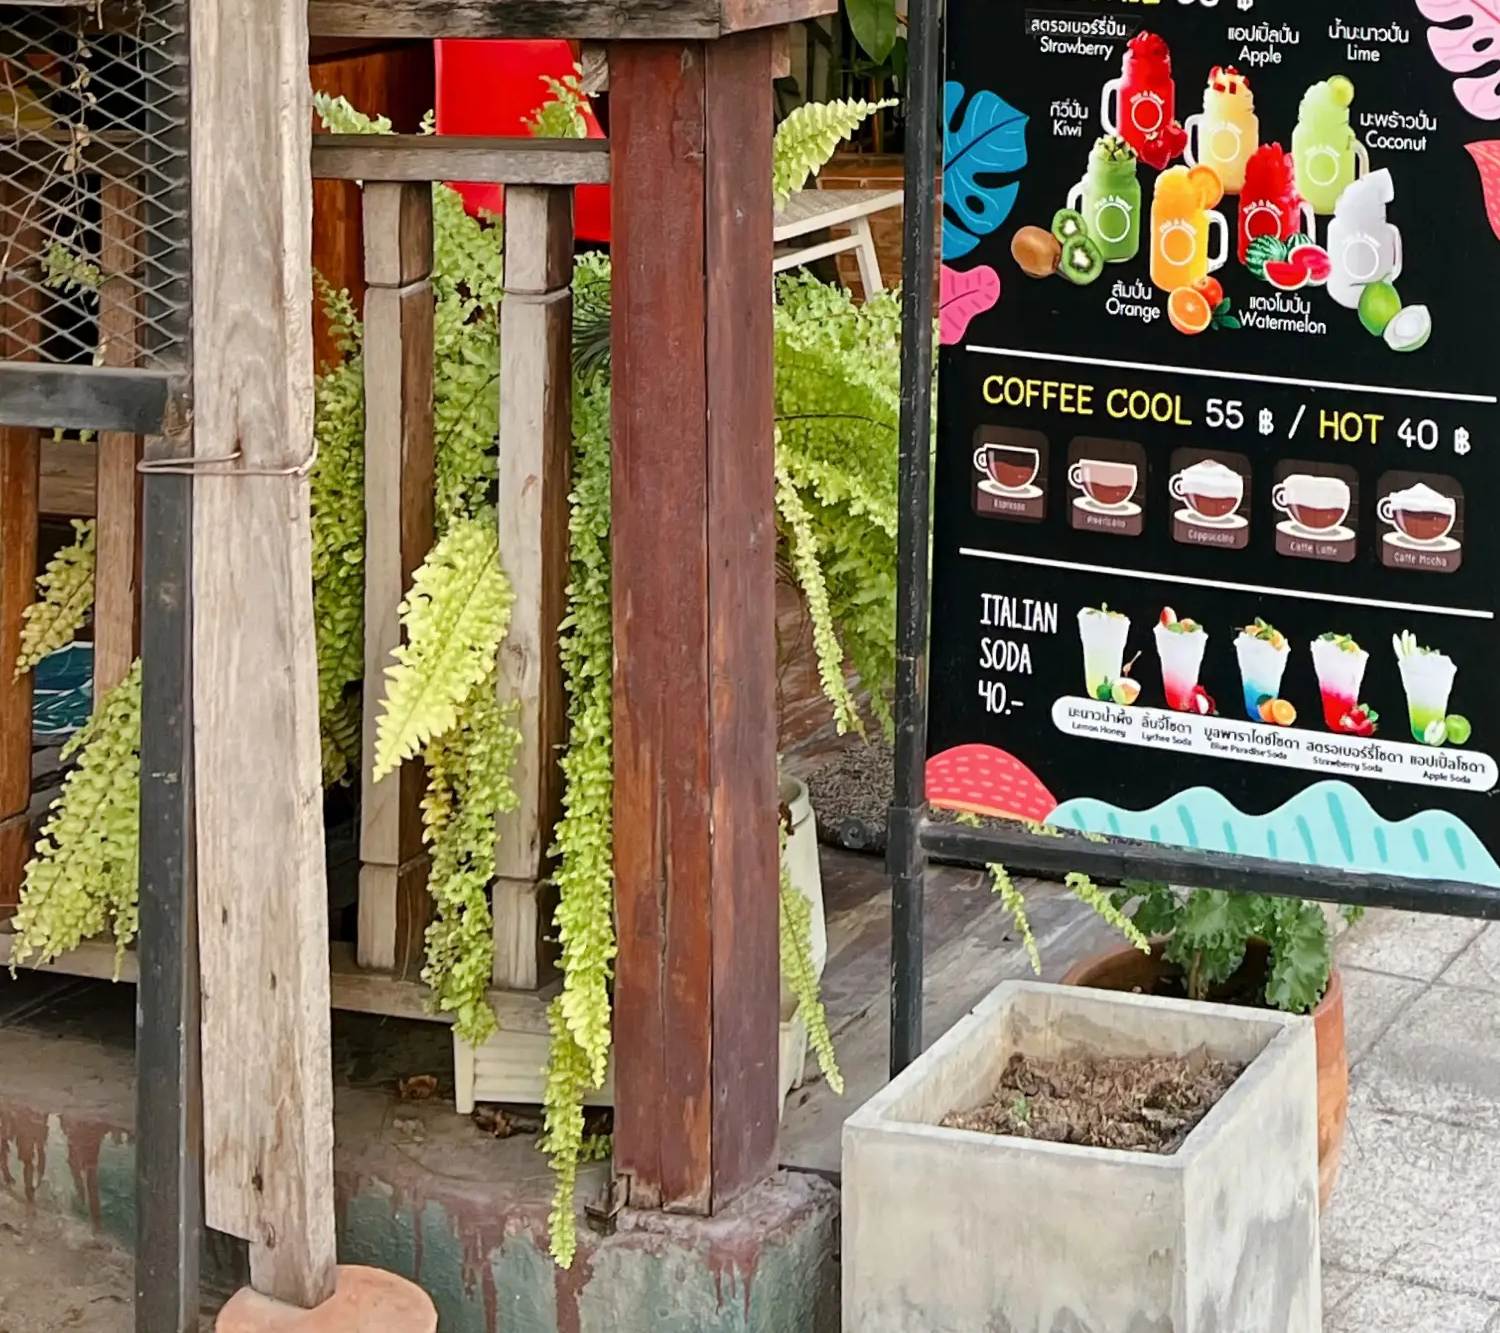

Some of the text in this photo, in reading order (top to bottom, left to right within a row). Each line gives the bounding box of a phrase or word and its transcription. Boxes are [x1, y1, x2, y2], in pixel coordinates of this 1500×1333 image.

[1040, 36, 1114, 61] Strawberry
[1238, 44, 1282, 68] Apple
[1347, 43, 1380, 62] Lime
[1053, 119, 1083, 137] Kiwi
[1365, 132, 1427, 151] Coconut
[1105, 298, 1161, 323] Orange
[1238, 309, 1327, 335] Watermelon
[982, 375, 1093, 415] COFFEE
[1106, 388, 1192, 426] COOL
[1205, 398, 1244, 429] 55
[1319, 409, 1384, 444] HOT
[1396, 418, 1439, 451] 40
[1418, 555, 1447, 568] Mocha
[979, 593, 1058, 634] ITALIAN
[979, 637, 1033, 675] SODA
[978, 680, 1024, 716] 40.-
[1072, 721, 1126, 738] Lemon Honey
[1142, 731, 1192, 746] Lychee Soda
[1210, 742, 1228, 752] Blue
[1267, 749, 1287, 760] Soda
[1313, 756, 1383, 773] Strawberry Soda
[1423, 770, 1471, 784] Apple Soda
